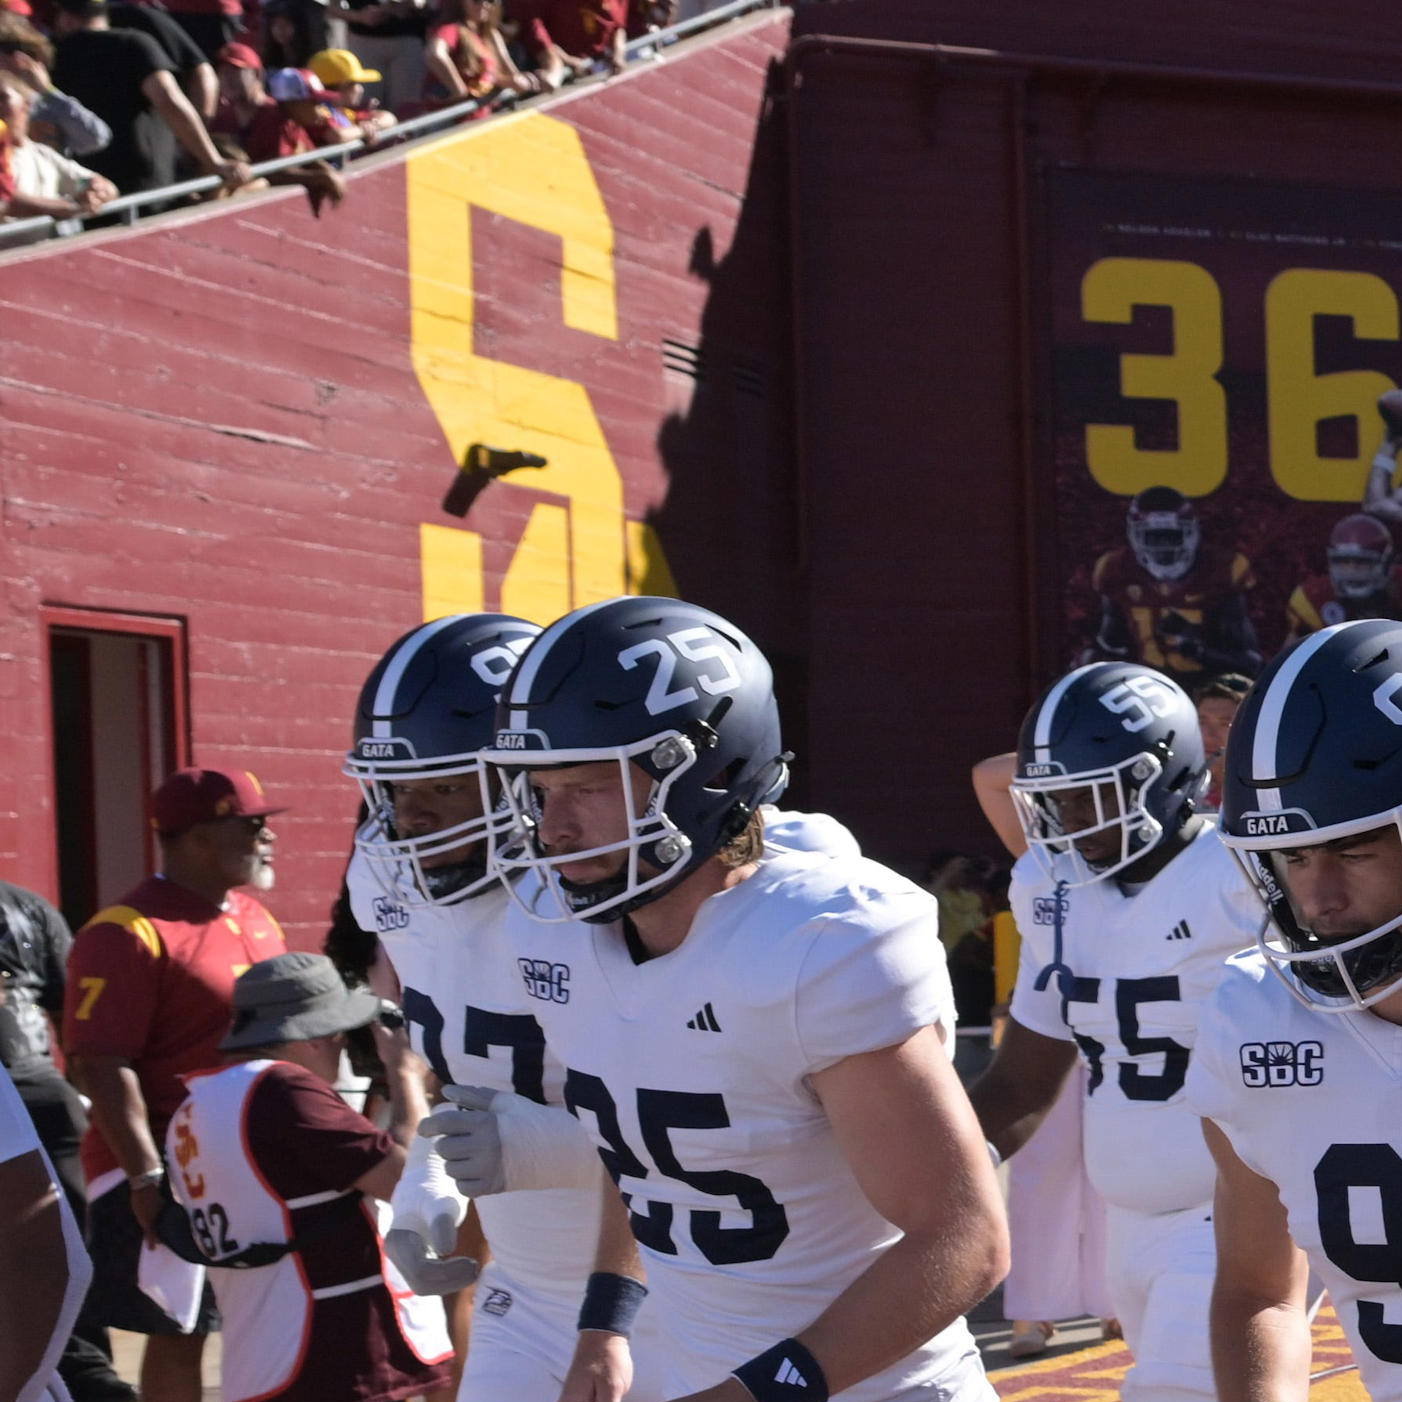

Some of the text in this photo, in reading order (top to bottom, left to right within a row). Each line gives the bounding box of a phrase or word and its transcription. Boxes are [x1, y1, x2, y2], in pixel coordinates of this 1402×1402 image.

[619, 626, 743, 716] 25
[1098, 675, 1177, 734] 55
[362, 743, 394, 758] GATA
[496, 734, 526, 750] GATA
[1026, 765, 1051, 777] GATA
[1247, 816, 1288, 835] GATA
[372, 896, 410, 932] SBC
[75, 977, 107, 1020] 7
[517, 957, 570, 1004] SBC
[1239, 1040, 1324, 1088] SBC
[565, 1068, 790, 1265] 25
